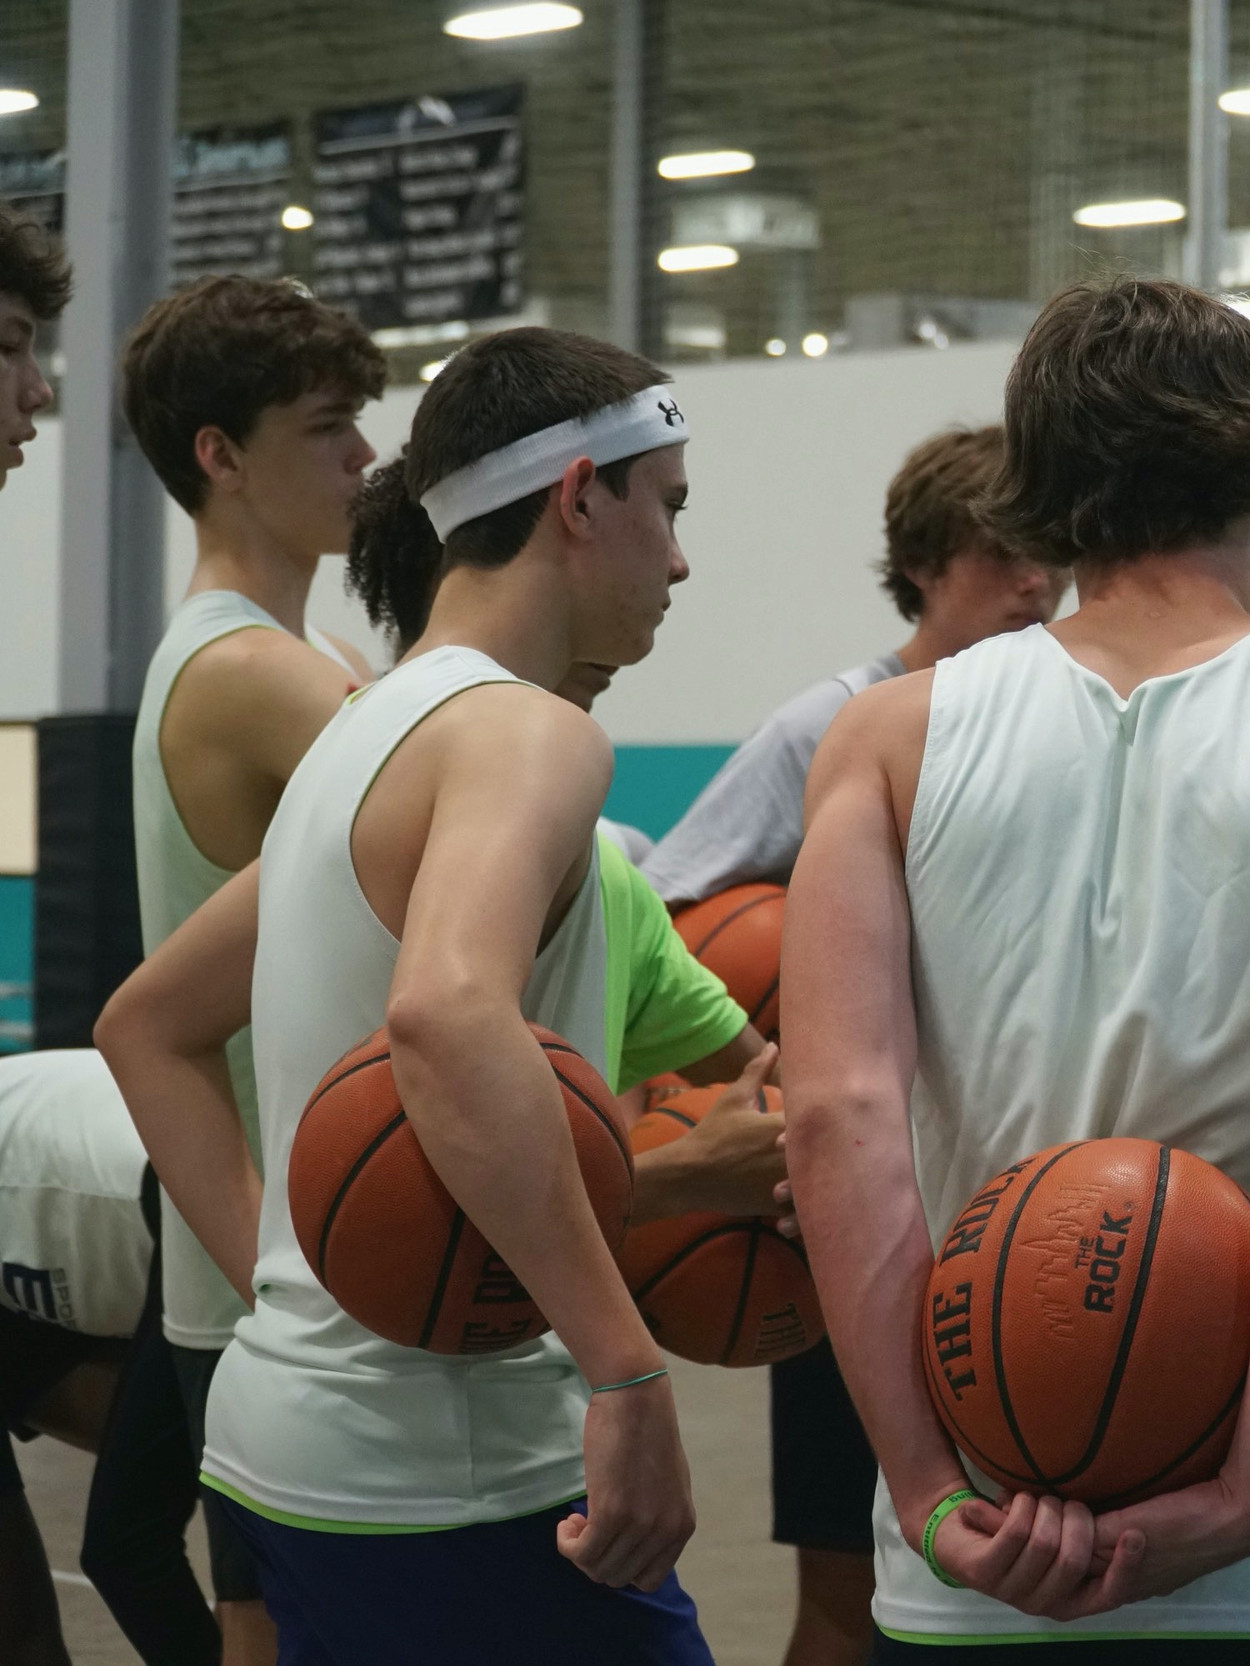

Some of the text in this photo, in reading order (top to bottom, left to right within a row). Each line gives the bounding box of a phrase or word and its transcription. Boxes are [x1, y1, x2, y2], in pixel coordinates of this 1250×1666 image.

[1074, 1237, 1095, 1270] THE
[1084, 1211, 1132, 1314] ROCK
[933, 1282, 973, 1401] THE
